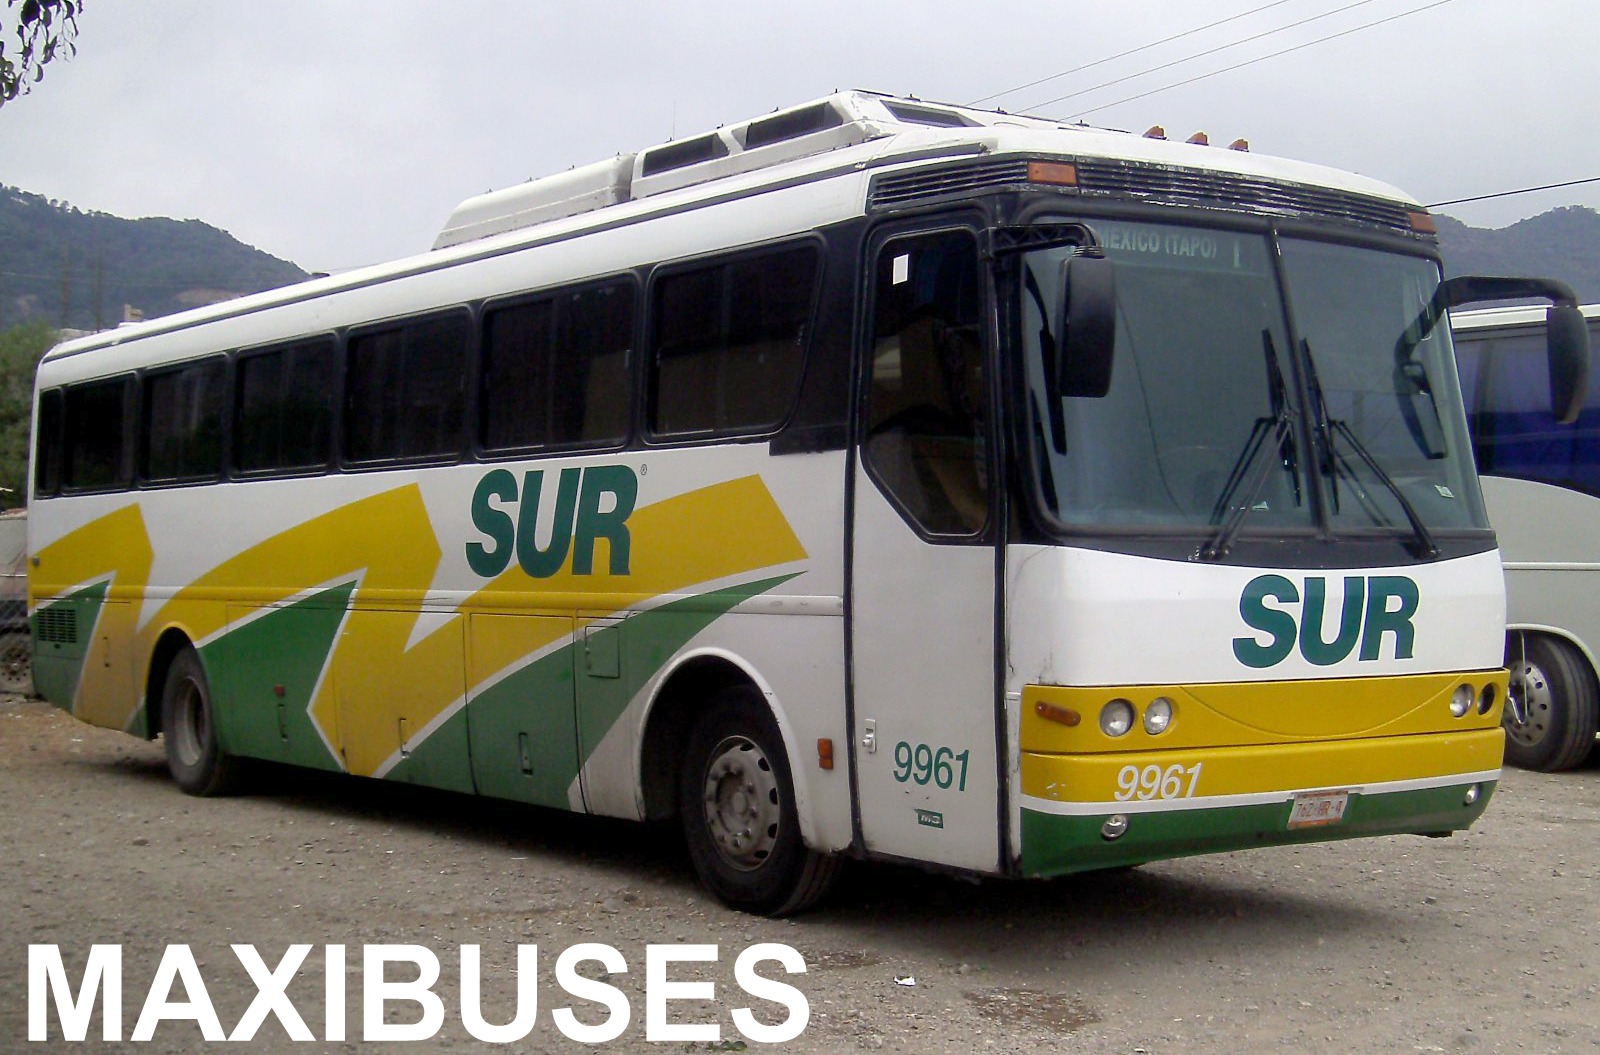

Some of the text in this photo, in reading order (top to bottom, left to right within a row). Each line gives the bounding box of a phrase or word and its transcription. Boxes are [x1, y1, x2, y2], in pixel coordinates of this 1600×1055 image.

[1165, 233, 1217, 259] (TAPO)
[465, 465, 638, 579] SUR
[1233, 574, 1420, 669] SUR
[893, 741, 969, 791] 9961
[1114, 763, 1202, 800] 9961
